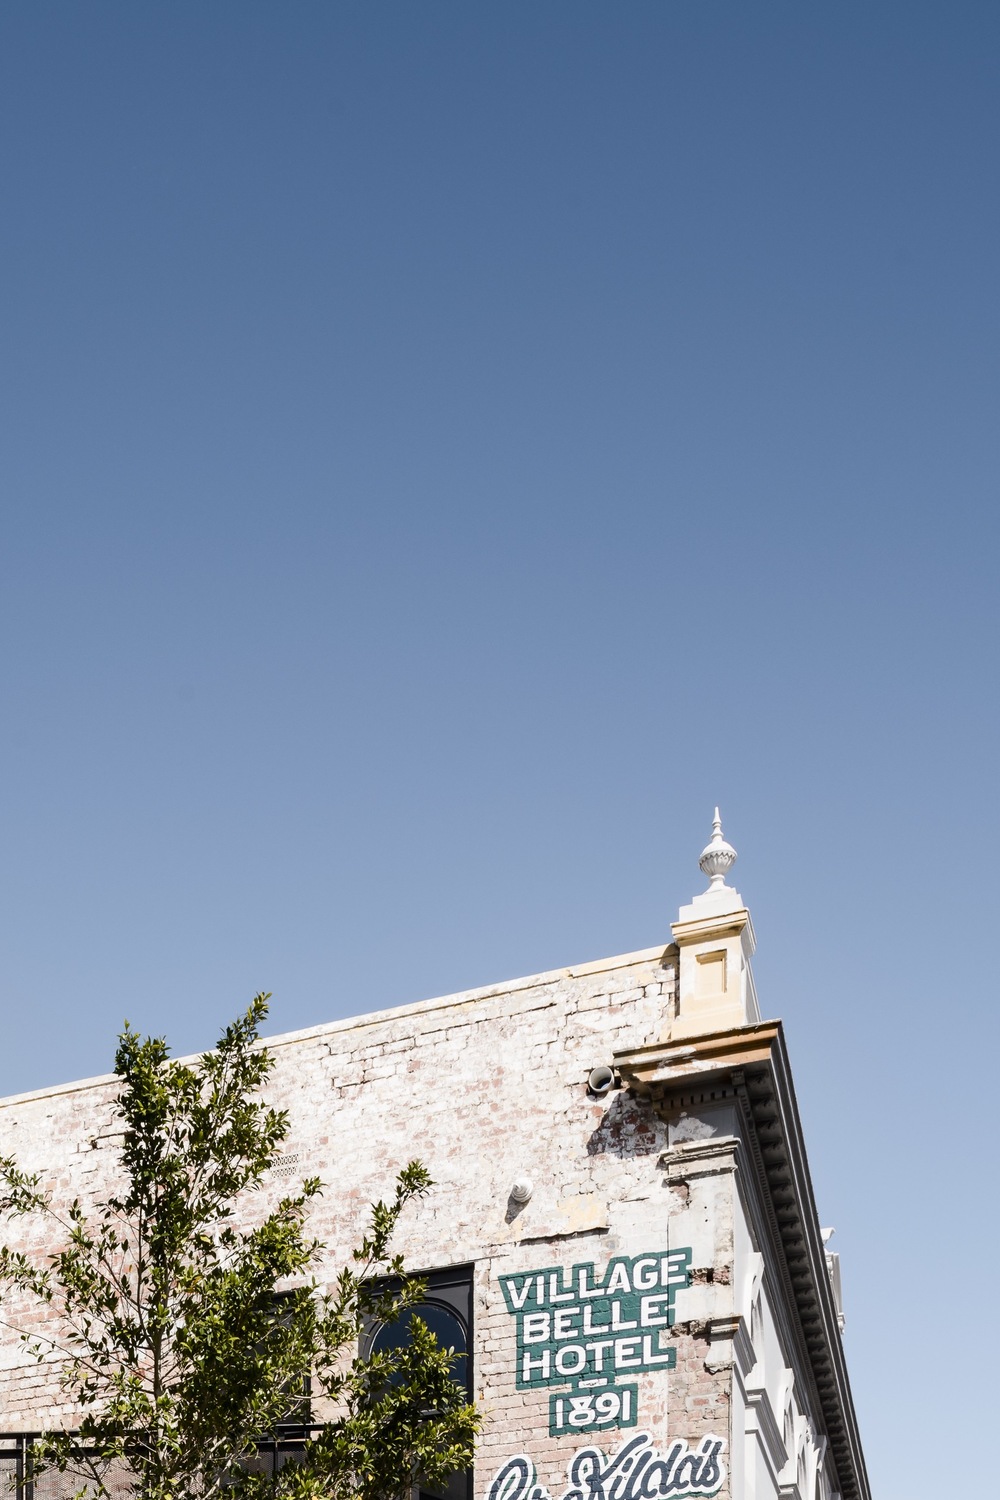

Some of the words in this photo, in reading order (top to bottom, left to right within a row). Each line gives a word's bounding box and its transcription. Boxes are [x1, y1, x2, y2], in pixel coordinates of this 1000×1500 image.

[505, 1252, 688, 1310] VILLAGE
[522, 1294, 670, 1345] BELLE
[522, 1337, 670, 1382] HOTEL
[555, 1389, 632, 1430] 1891
